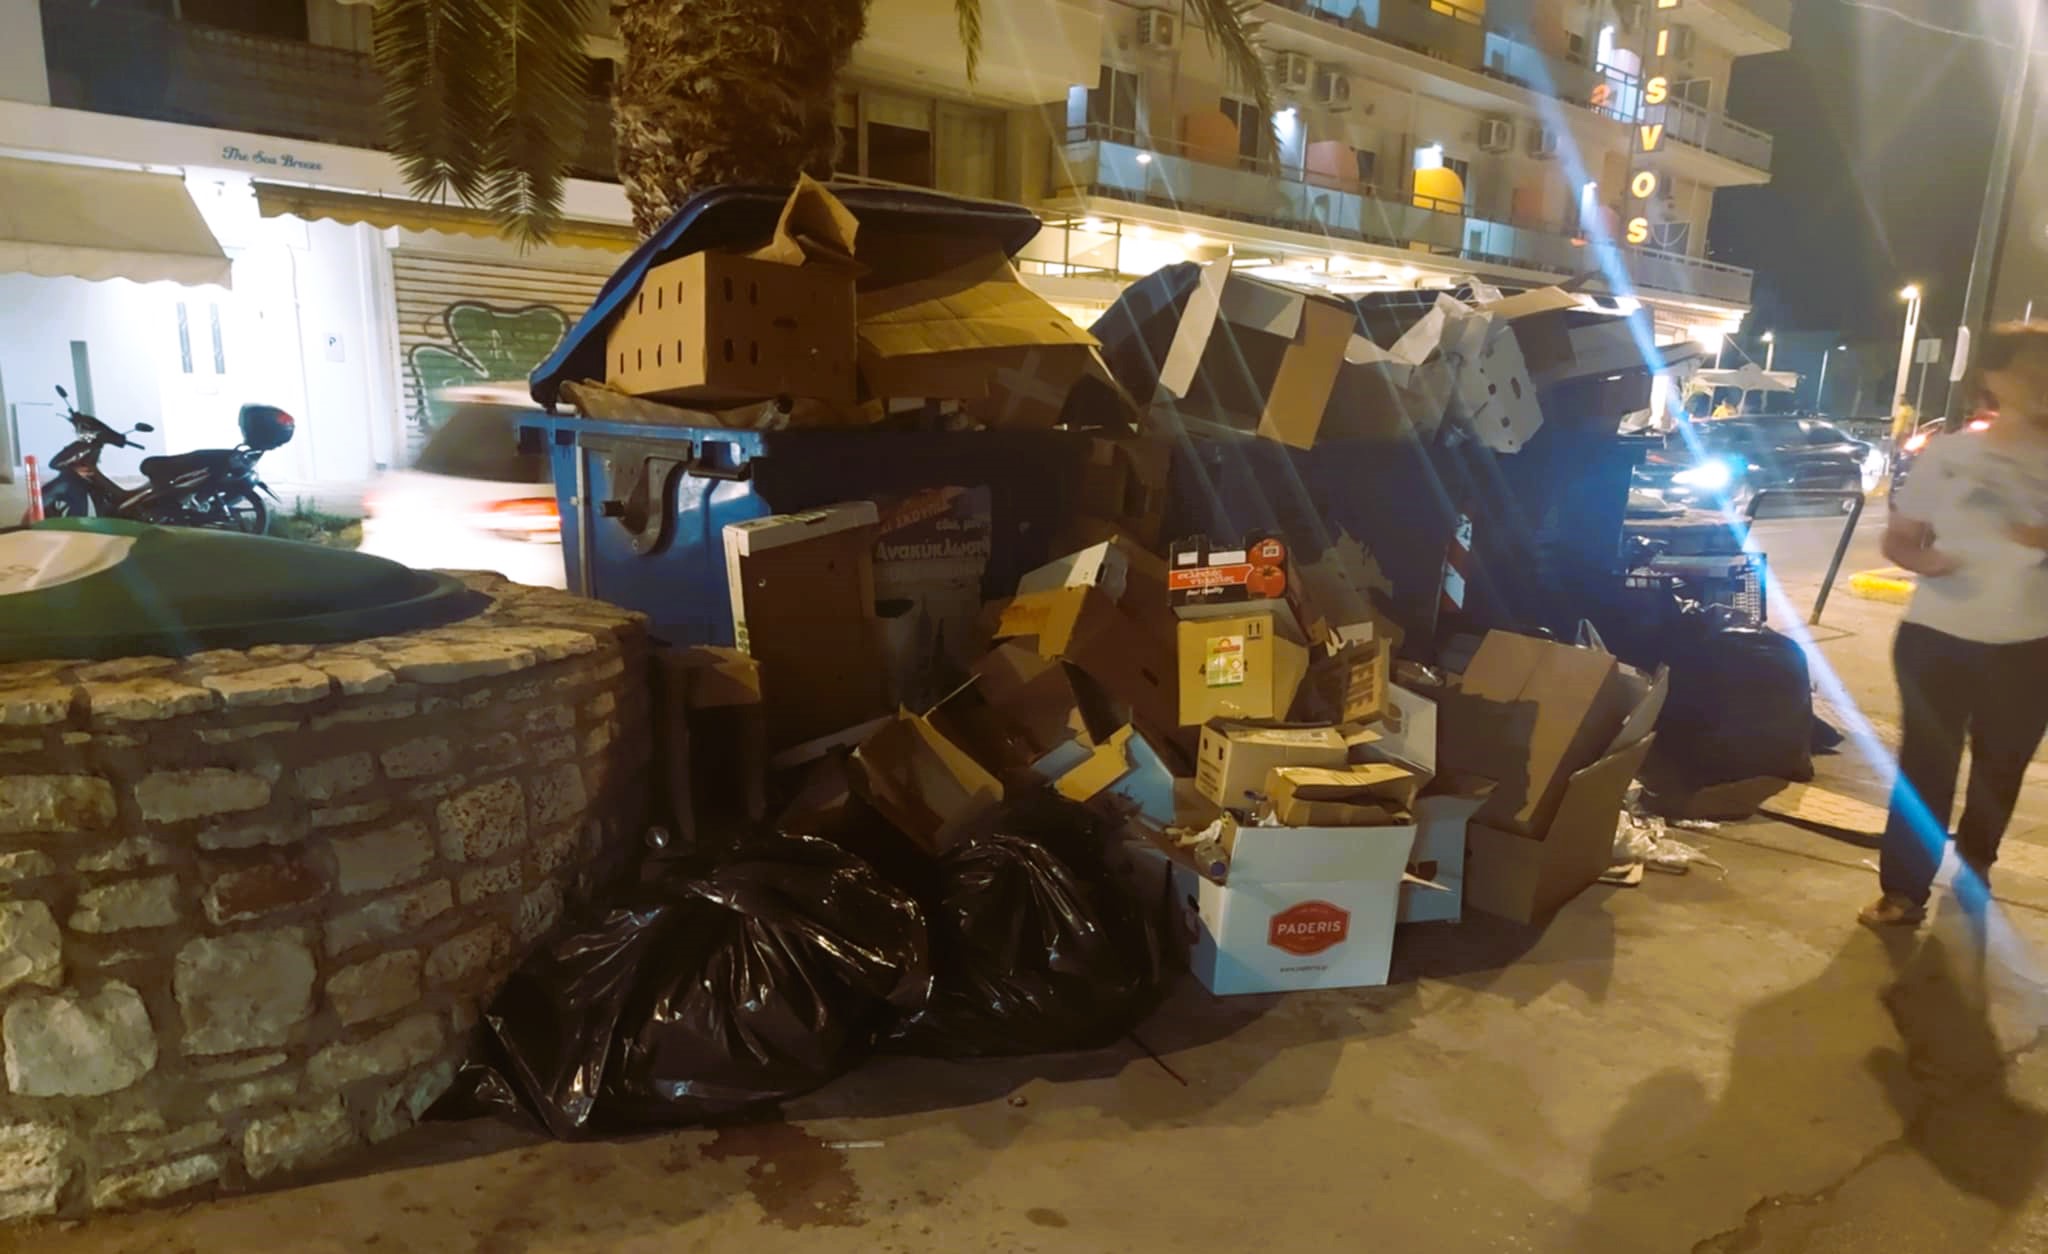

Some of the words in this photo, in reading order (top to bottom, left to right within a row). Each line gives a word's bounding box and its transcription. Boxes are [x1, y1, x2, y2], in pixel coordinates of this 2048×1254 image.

[1626, 0, 1678, 244] ISVOS
[222, 146, 248, 161] The
[252, 150, 277, 165] Sea
[281, 153, 322, 171] Breeze
[1277, 920, 1342, 936] PADERIS
